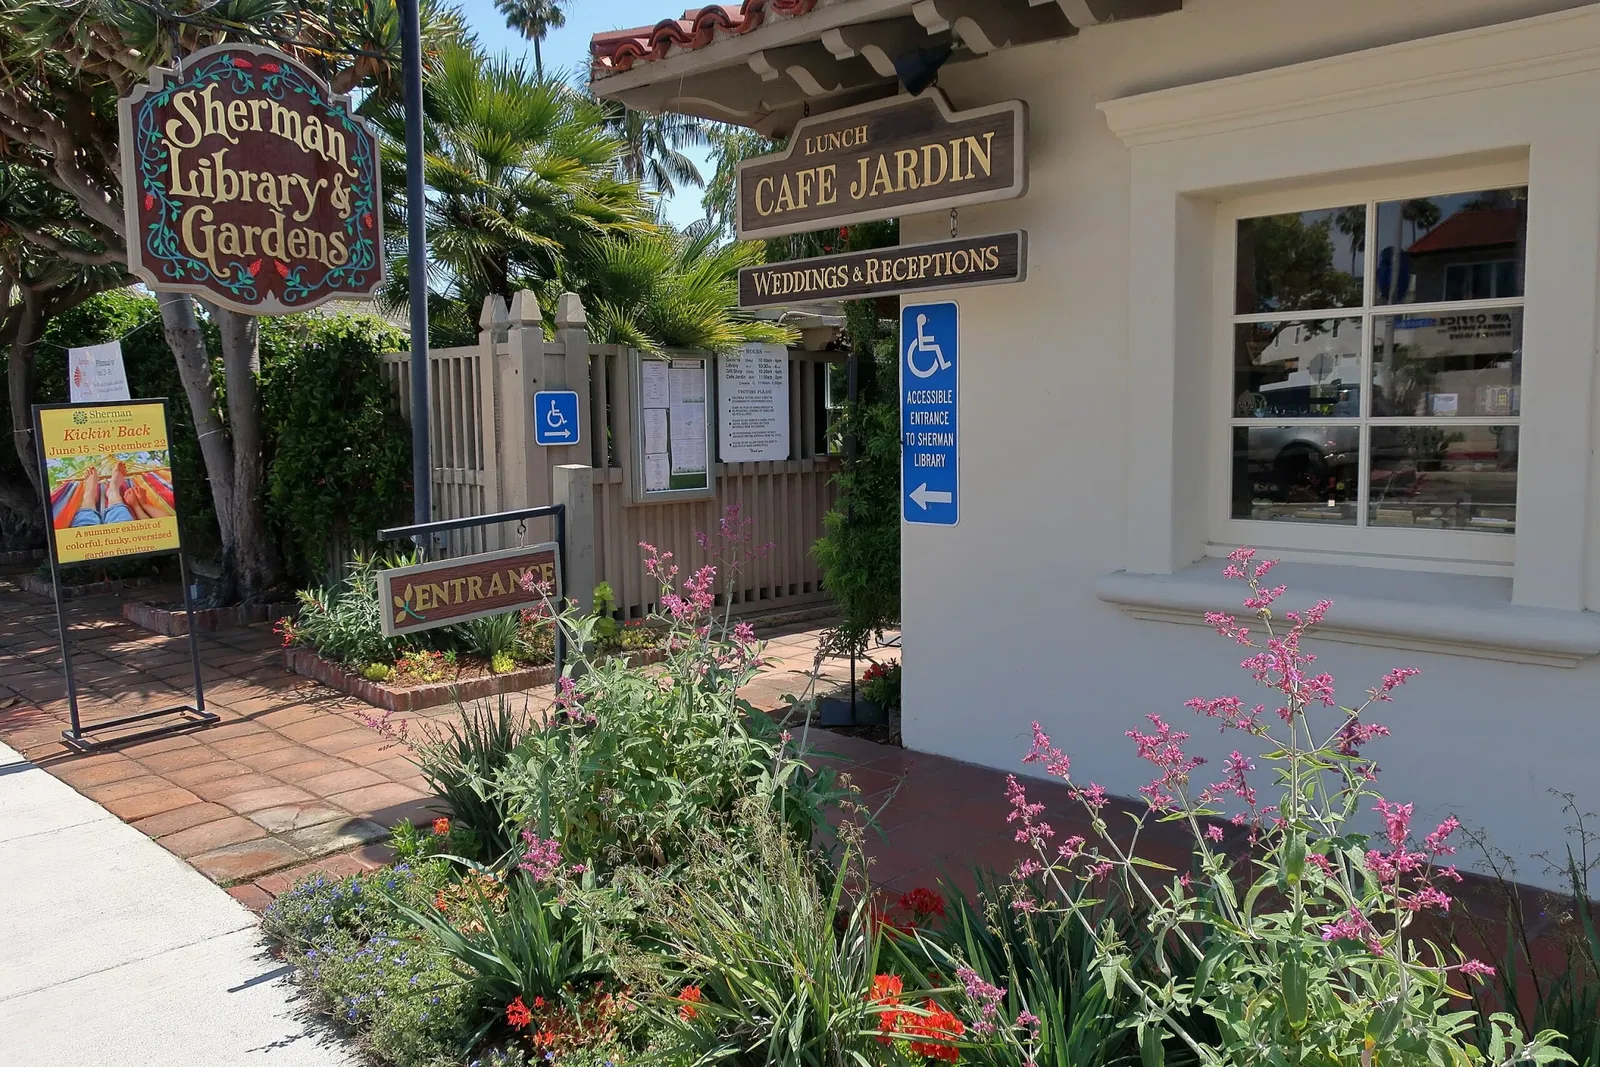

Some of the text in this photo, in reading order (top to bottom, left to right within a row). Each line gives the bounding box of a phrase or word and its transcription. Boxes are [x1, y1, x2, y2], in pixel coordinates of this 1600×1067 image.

[165, 83, 358, 177] Sherman
[805, 125, 868, 155] LUNCH
[161, 139, 350, 221] Library &
[755, 131, 995, 216] CAFE JARDIN
[181, 205, 348, 278] Gardens
[752, 245, 999, 296] WEDDINGS & RECEPTIONS
[907, 390, 953, 404] ACCESSIBLE
[89, 410, 132, 419] Sherman
[910, 411, 949, 425] ENTRANCE
[117, 424, 151, 438] Back
[906, 432, 954, 446] TO SHERMAN
[49, 446, 75, 456] June
[78, 444, 90, 454] 15
[98, 440, 152, 452] September
[153, 438, 166, 448] 22
[914, 453, 946, 467] LIBRARY
[75, 521, 162, 538] A summer exhibit of
[65, 539, 104, 551] colorful,
[132, 530, 172, 543] oversized
[84, 550, 115, 560] garden
